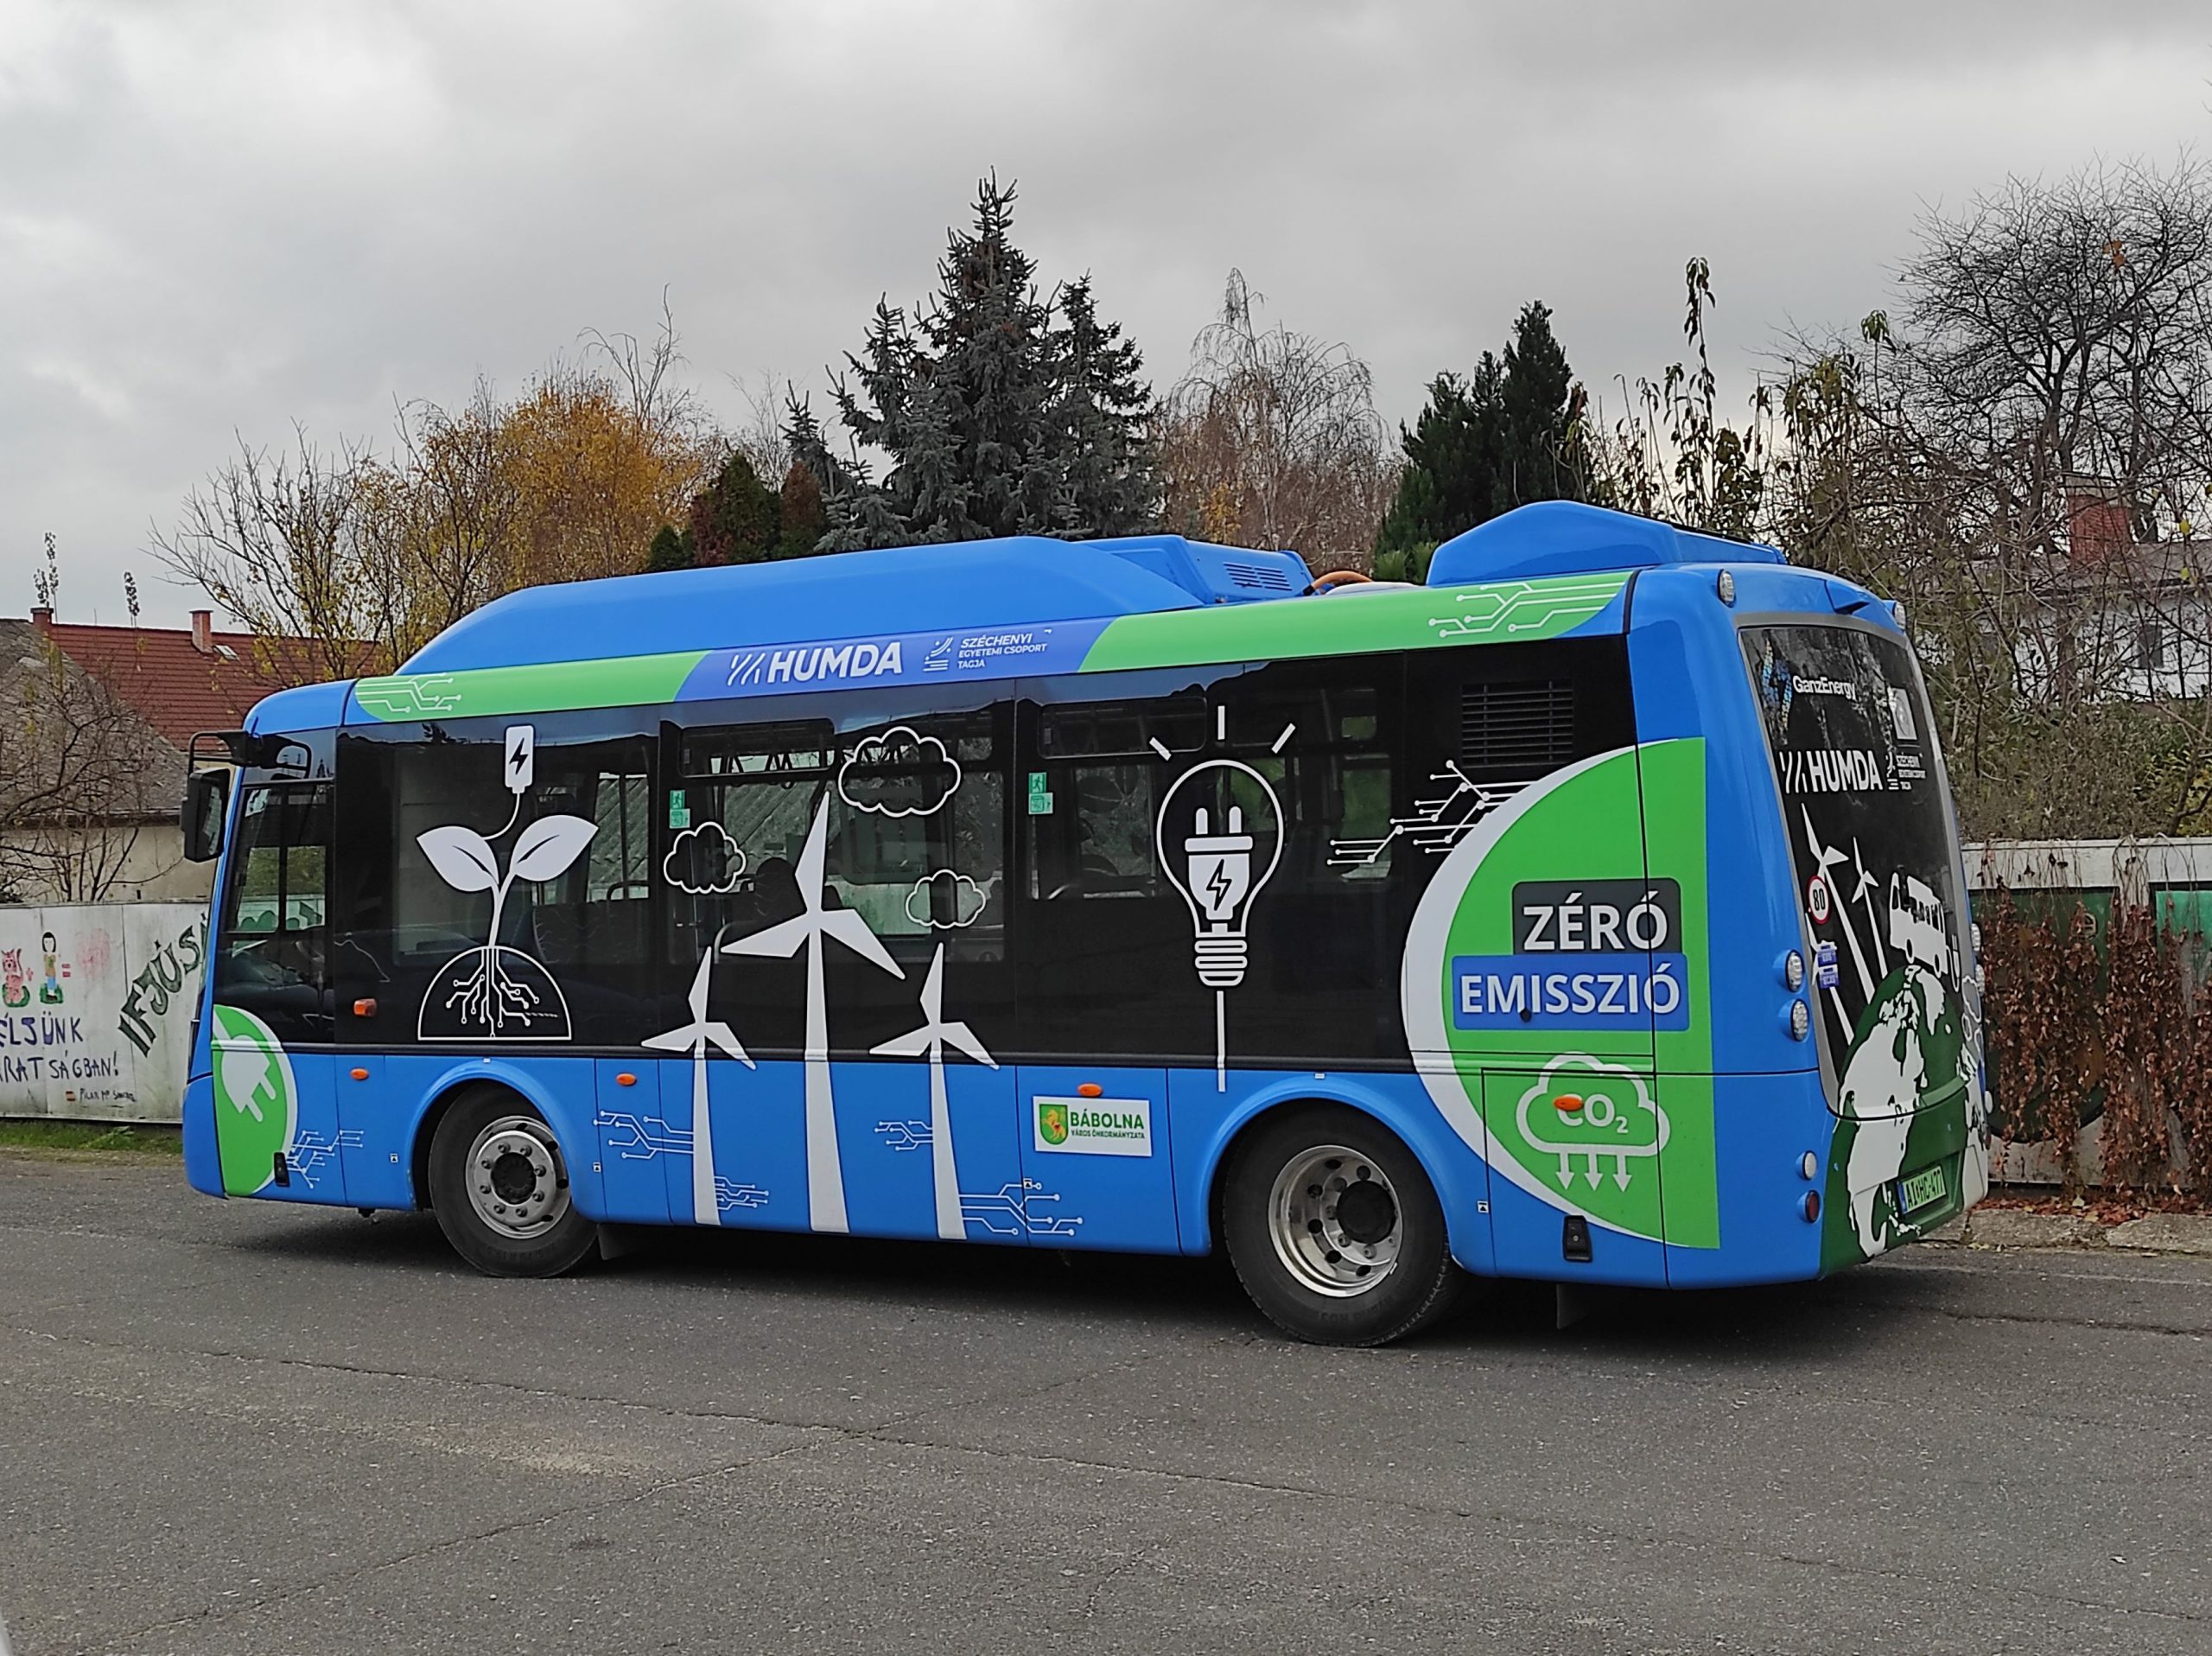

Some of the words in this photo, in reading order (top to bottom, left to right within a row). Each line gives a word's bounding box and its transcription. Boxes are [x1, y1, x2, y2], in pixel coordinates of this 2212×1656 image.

[958, 647, 1002, 659] EGYETEMI
[1003, 643, 1048, 654] CSOPORT
[960, 634, 1033, 649] SZÉCHENYI
[766, 641, 903, 684] HUMDA
[957, 659, 985, 670] TAGJA
[1792, 675, 1858, 701] GanzEnergy
[1806, 750, 1884, 793] HUMDA
[1812, 888, 1826, 911] 80
[1522, 890, 1669, 952] ZÉRÓ
[1460, 963, 1681, 1015] EMISSZIÓ
[1070, 1108, 1144, 1130] BÁBOLNA
[1071, 1129, 1091, 1137] VÁROS
